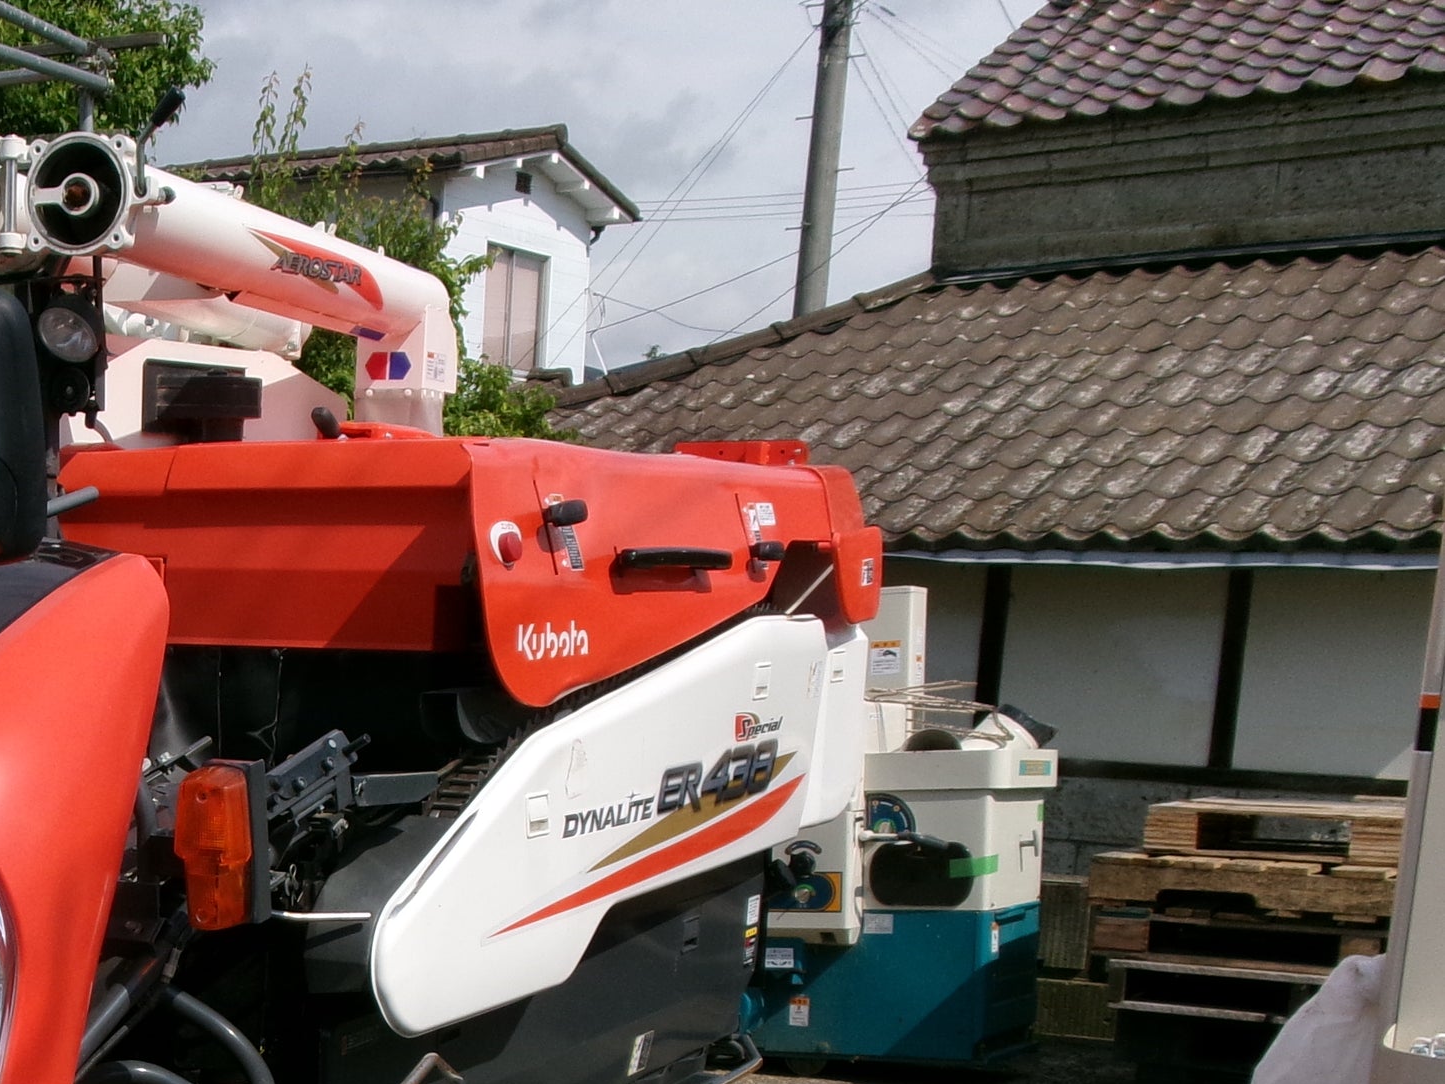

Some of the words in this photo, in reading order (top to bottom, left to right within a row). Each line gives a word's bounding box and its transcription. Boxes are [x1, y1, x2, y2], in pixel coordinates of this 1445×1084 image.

[271, 252, 363, 286] AEROSTAR
[517, 620, 589, 661] Kubota
[739, 716, 783, 740] Special
[562, 795, 655, 838] DYNALITE
